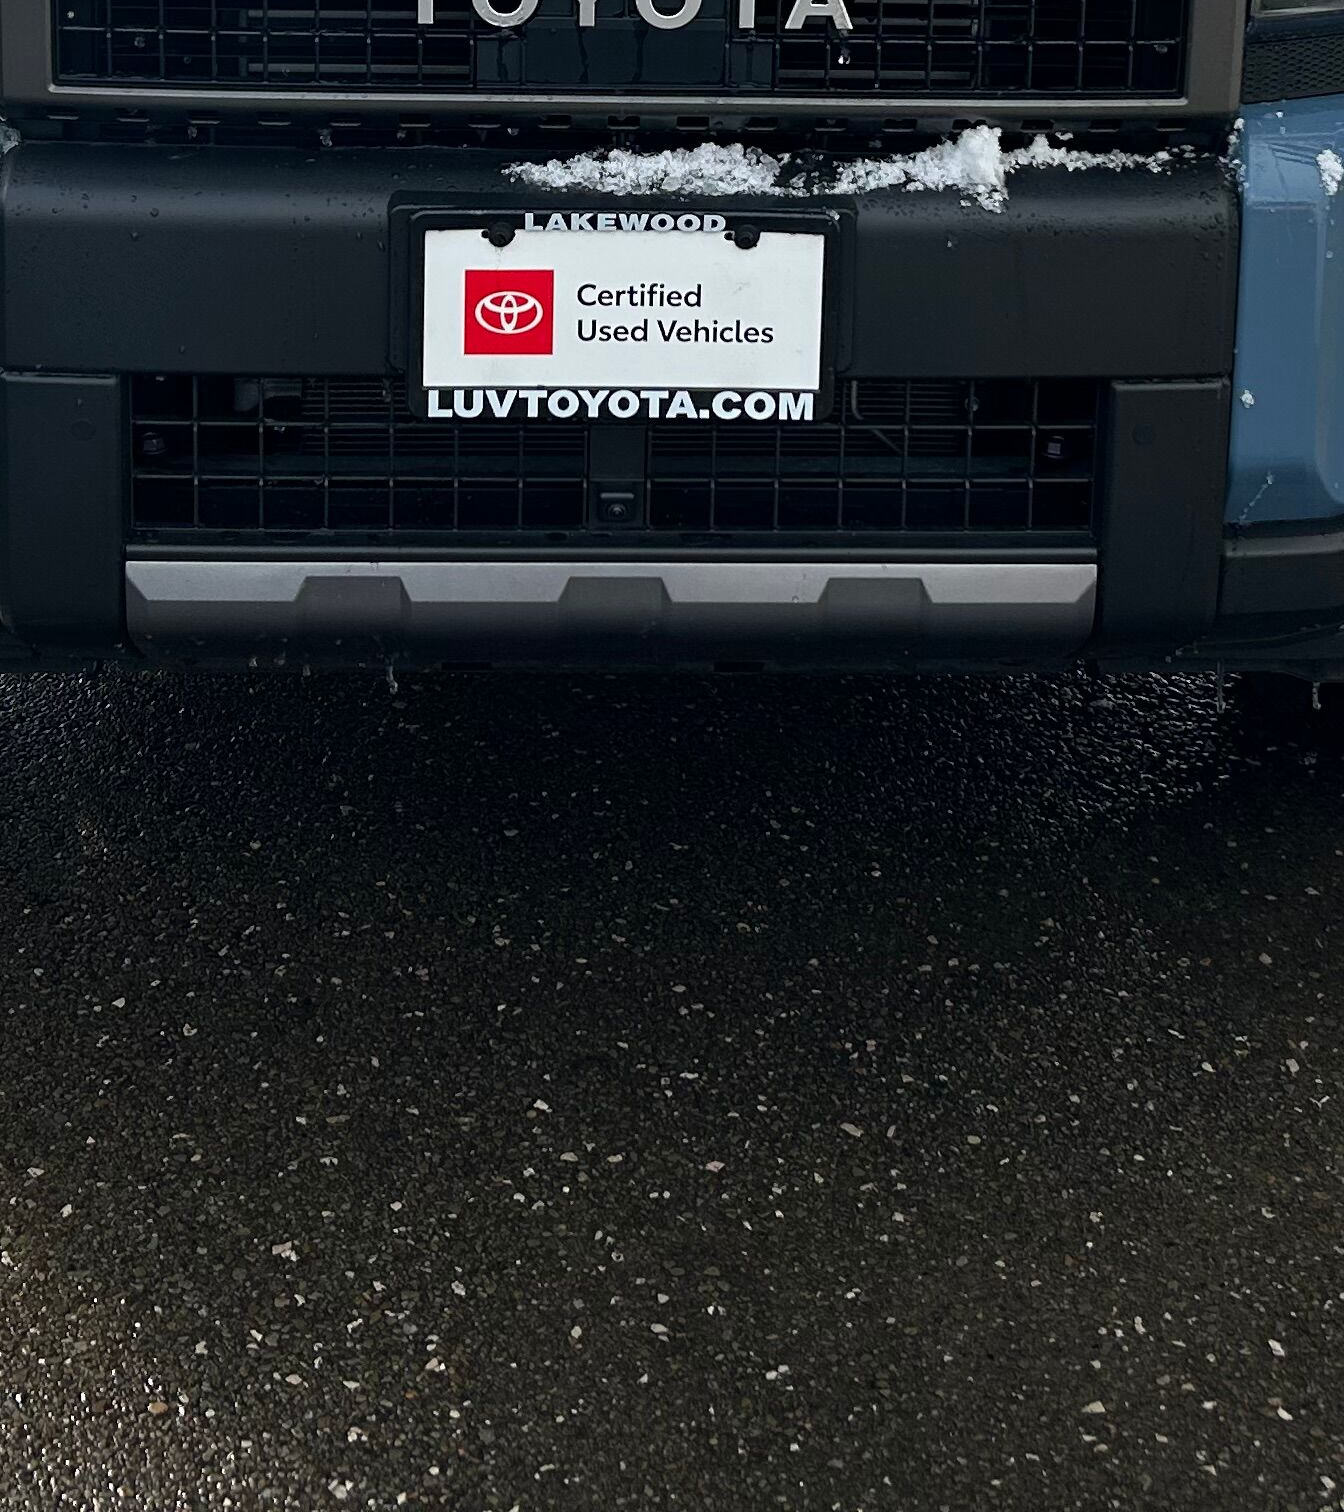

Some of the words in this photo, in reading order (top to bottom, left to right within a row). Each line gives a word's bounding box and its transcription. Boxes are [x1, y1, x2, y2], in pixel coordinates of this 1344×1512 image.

[524, 212, 727, 233] LAKEWOOD
[576, 283, 702, 308] Certified
[577, 319, 649, 343] Used
[656, 319, 774, 344] Vehicles
[427, 389, 814, 421] LUVTOYOTA.COM
